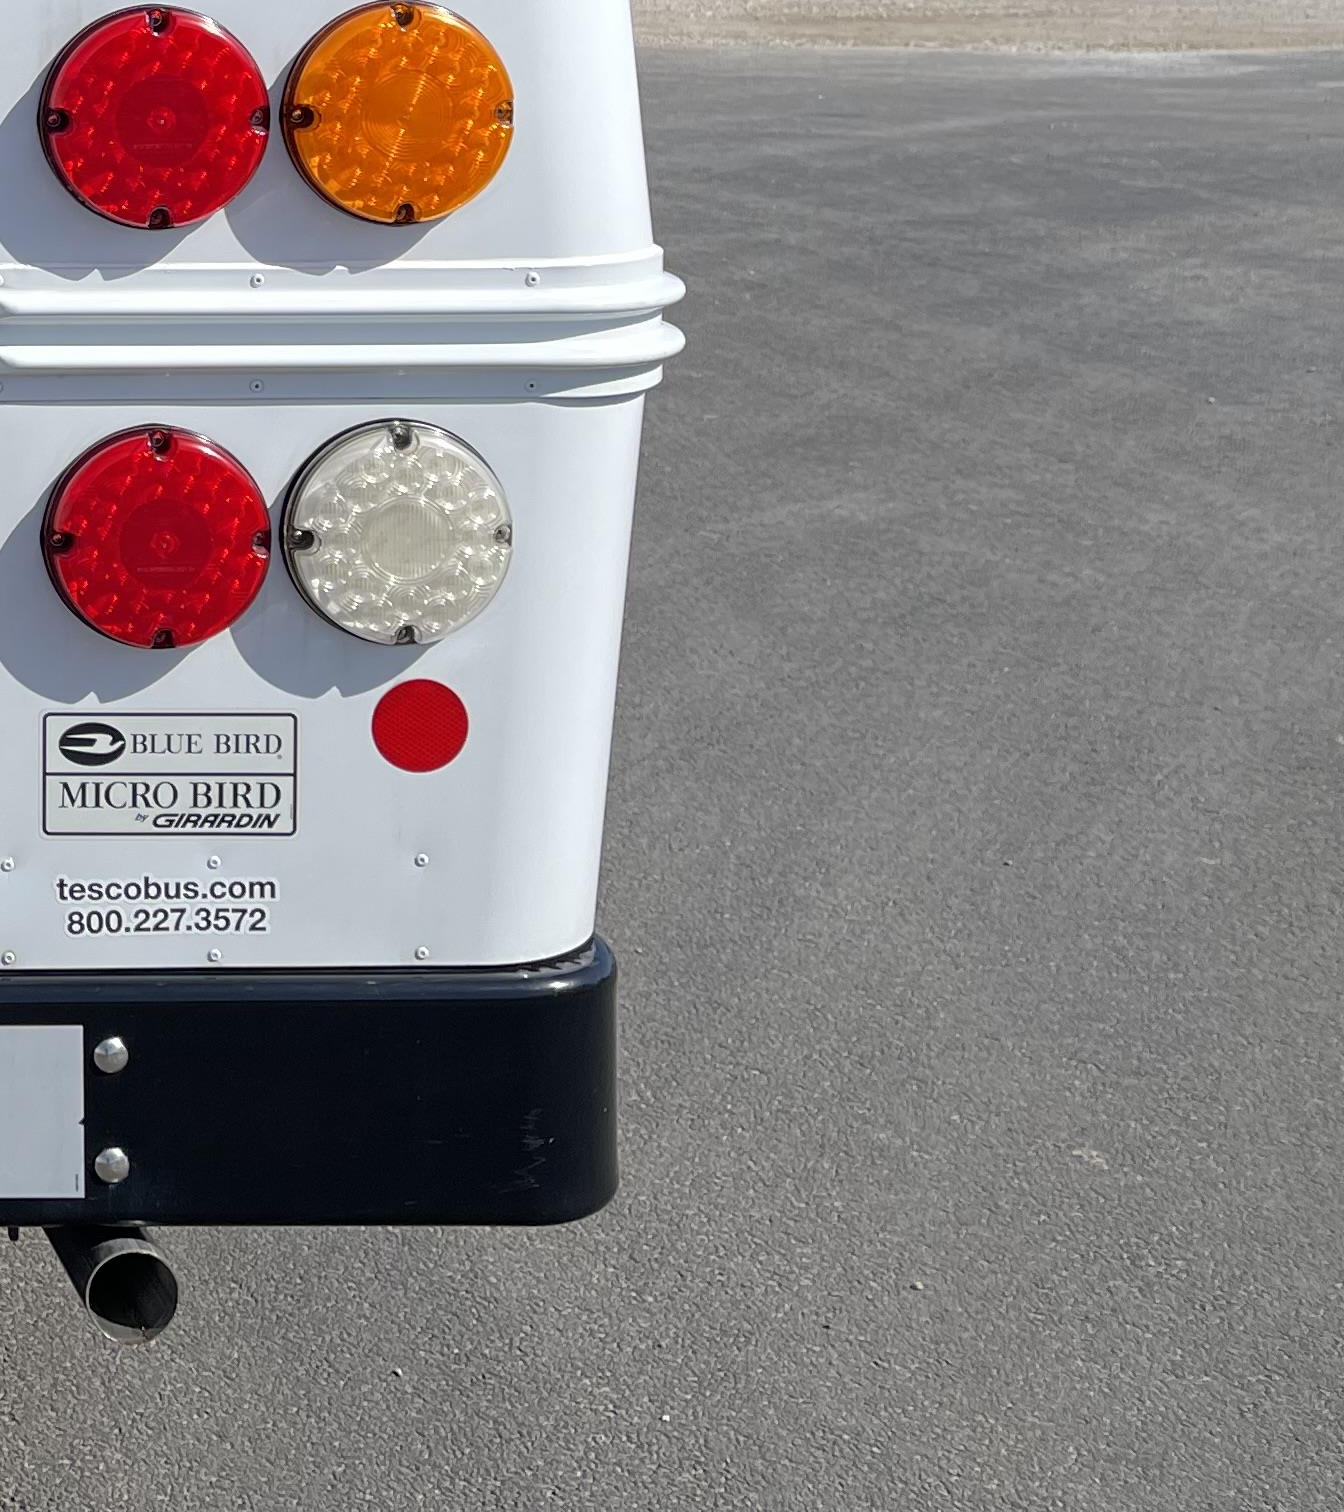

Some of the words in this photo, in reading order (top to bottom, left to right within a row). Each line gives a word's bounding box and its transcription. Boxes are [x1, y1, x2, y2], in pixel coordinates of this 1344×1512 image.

[130, 733, 203, 755] BLUE
[213, 732, 283, 755] BIRD
[58, 781, 179, 809] MICRO
[188, 781, 282, 809] BIRD
[134, 812, 149, 823] by
[152, 813, 280, 829] GIRARDIN
[56, 876, 276, 901] tescobus.com
[67, 908, 267, 935] 800.227.3572
